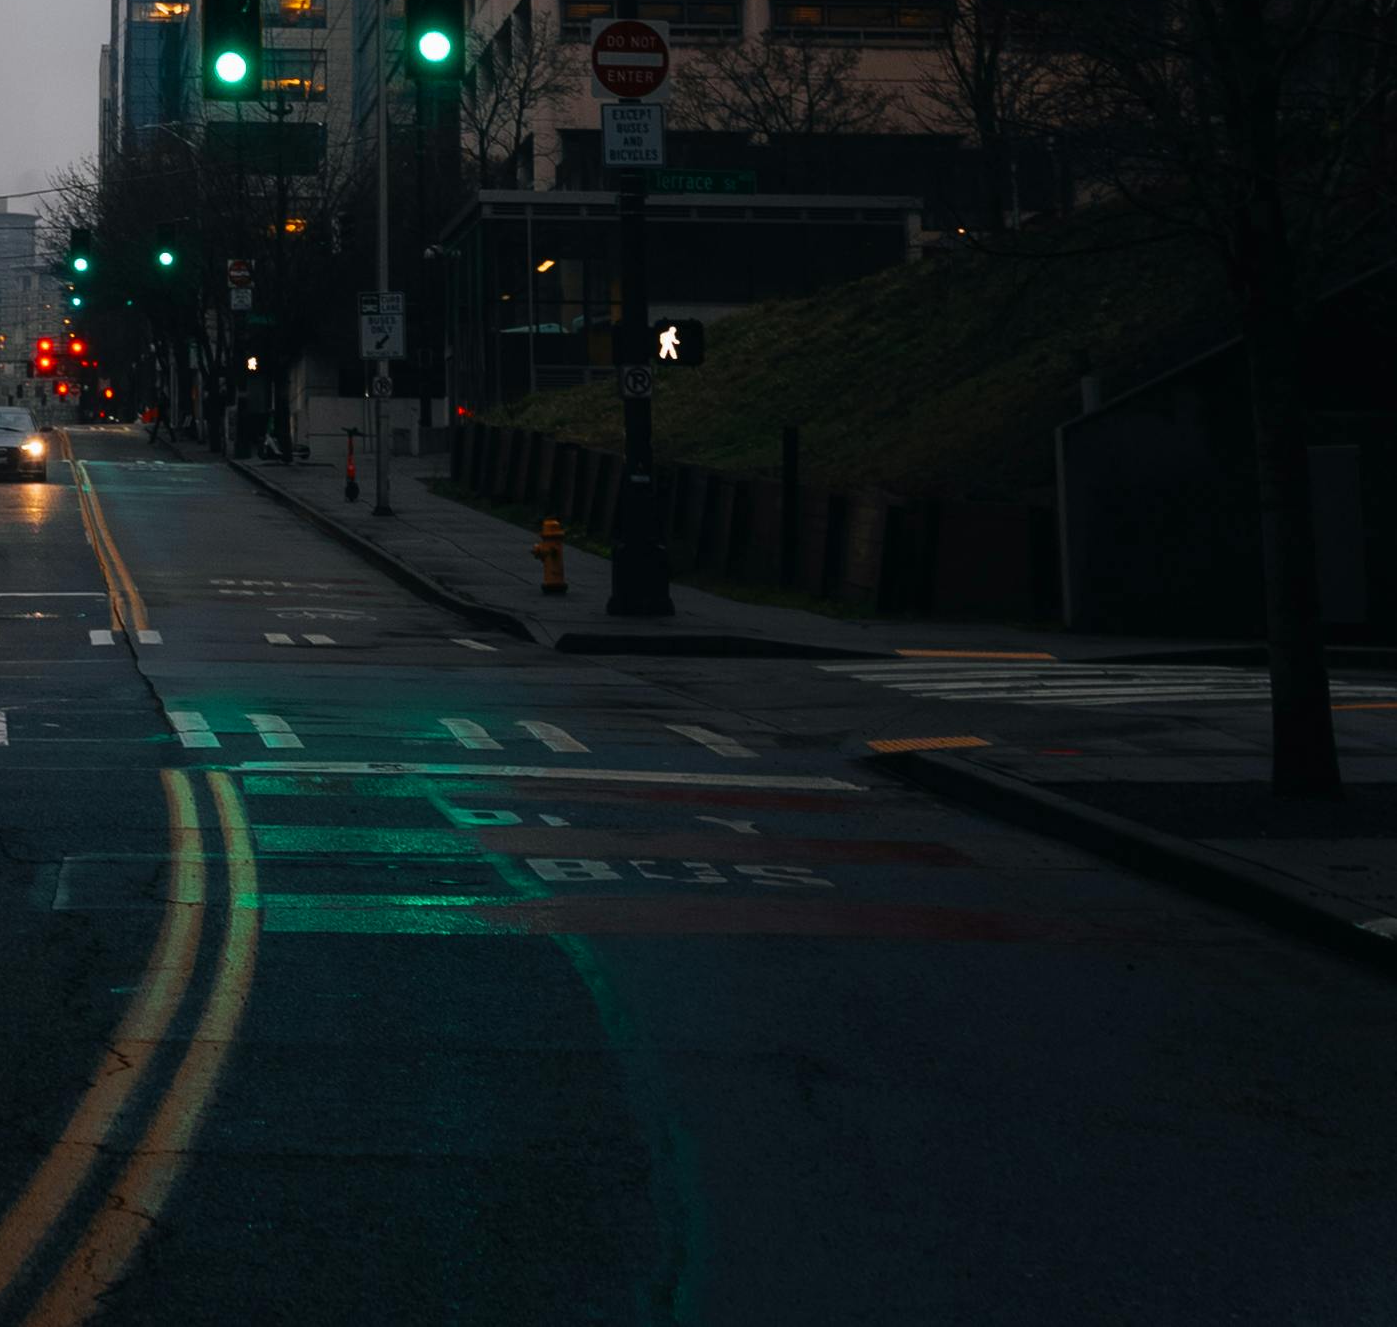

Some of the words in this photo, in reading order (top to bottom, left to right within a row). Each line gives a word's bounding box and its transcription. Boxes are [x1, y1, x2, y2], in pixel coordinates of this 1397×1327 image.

[606, 35, 625, 48] DO
[630, 36, 657, 49] NOT
[607, 69, 654, 83] ENTER
[612, 108, 652, 121] EXCEPT
[616, 123, 650, 134] BUSES
[623, 136, 644, 147] AND
[609, 148, 659, 162] BICYCLES
[655, 171, 714, 191] Terrace
[524, 857, 837, 888] BUS
